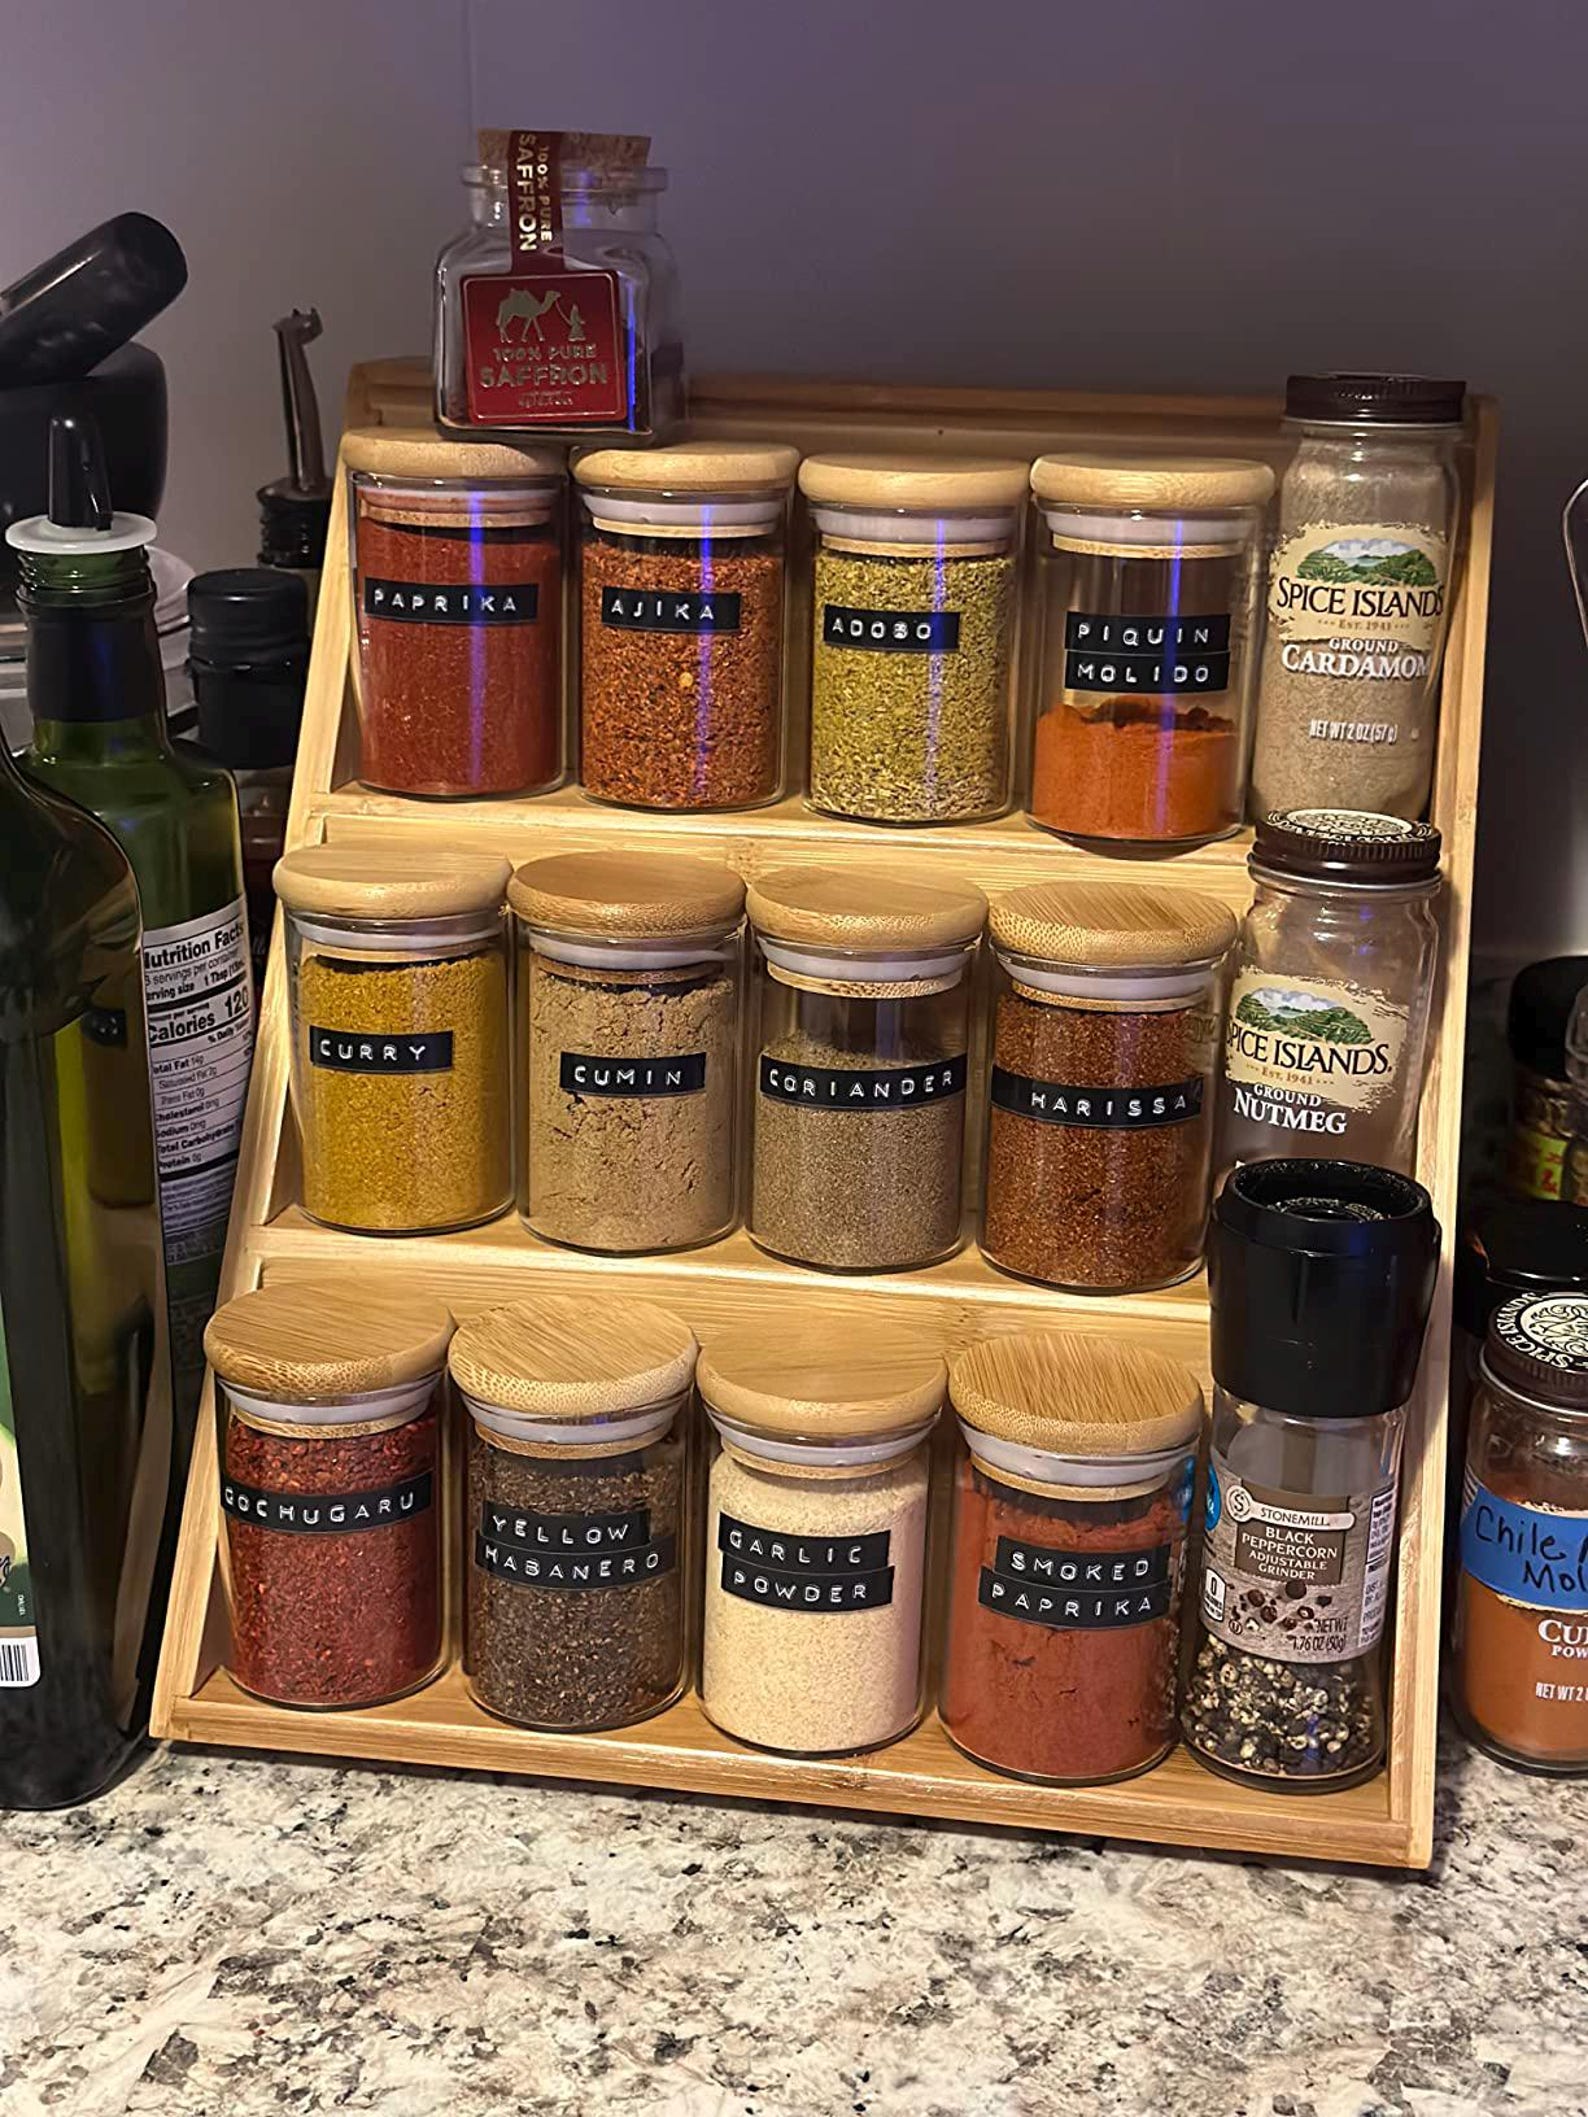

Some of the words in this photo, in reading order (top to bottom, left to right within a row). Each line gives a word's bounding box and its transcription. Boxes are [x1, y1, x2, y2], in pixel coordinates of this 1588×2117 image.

[518, 133, 537, 251] SAFFRON
[540, 196, 552, 241] PURE
[549, 343, 597, 360] PURE
[479, 363, 607, 388] SAFFRON
[374, 588, 516, 613] PAPRIKA
[611, 598, 715, 621] AJIKA
[1277, 576, 1346, 616] SPICE
[1352, 584, 1445, 618] ISLANDS
[832, 617, 932, 640] ADOBO
[1078, 623, 1210, 647] PIQUIN
[1329, 638, 1399, 654] GROUND
[1077, 663, 1210, 685] MOLIDO
[1309, 719, 1328, 739] NET
[1329, 720, 1345, 740] WT
[149, 1012, 216, 1042] Calories
[224, 984, 249, 1018] 120
[319, 1038, 427, 1062] CURRY
[1228, 1021, 1268, 1063] PICE
[153, 1061, 173, 1076] otal
[573, 1064, 682, 1087] CUMIN
[1286, 1070, 1313, 1085] 1941
[768, 1067, 954, 1100] CORIANDER
[1253, 1084, 1322, 1107] GROUND
[1031, 1091, 1188, 1118] HARISSA
[1233, 1087, 1348, 1135] NUTMEG
[224, 1485, 415, 1525] GOCHUGARU
[491, 1513, 630, 1545] YELLOW
[1265, 1526, 1315, 1545] BLACK
[1476, 1505, 1567, 1561] Chile
[730, 1529, 862, 1564] GARLIC
[1241, 1532, 1338, 1559] PEPPERCORN
[485, 1543, 660, 1582] HABANERO
[1011, 1551, 1150, 1582] SMOKED
[1248, 1550, 1329, 1571] ADJUSTABLE
[1258, 1564, 1316, 1581] GRINDER
[732, 1571, 868, 1603] POWDER
[992, 1582, 1153, 1618] PAPRIKA
[1538, 1619, 1588, 1646] CU
[1535, 1681, 1556, 1700] NET
[1557, 1684, 1575, 1701] WT
